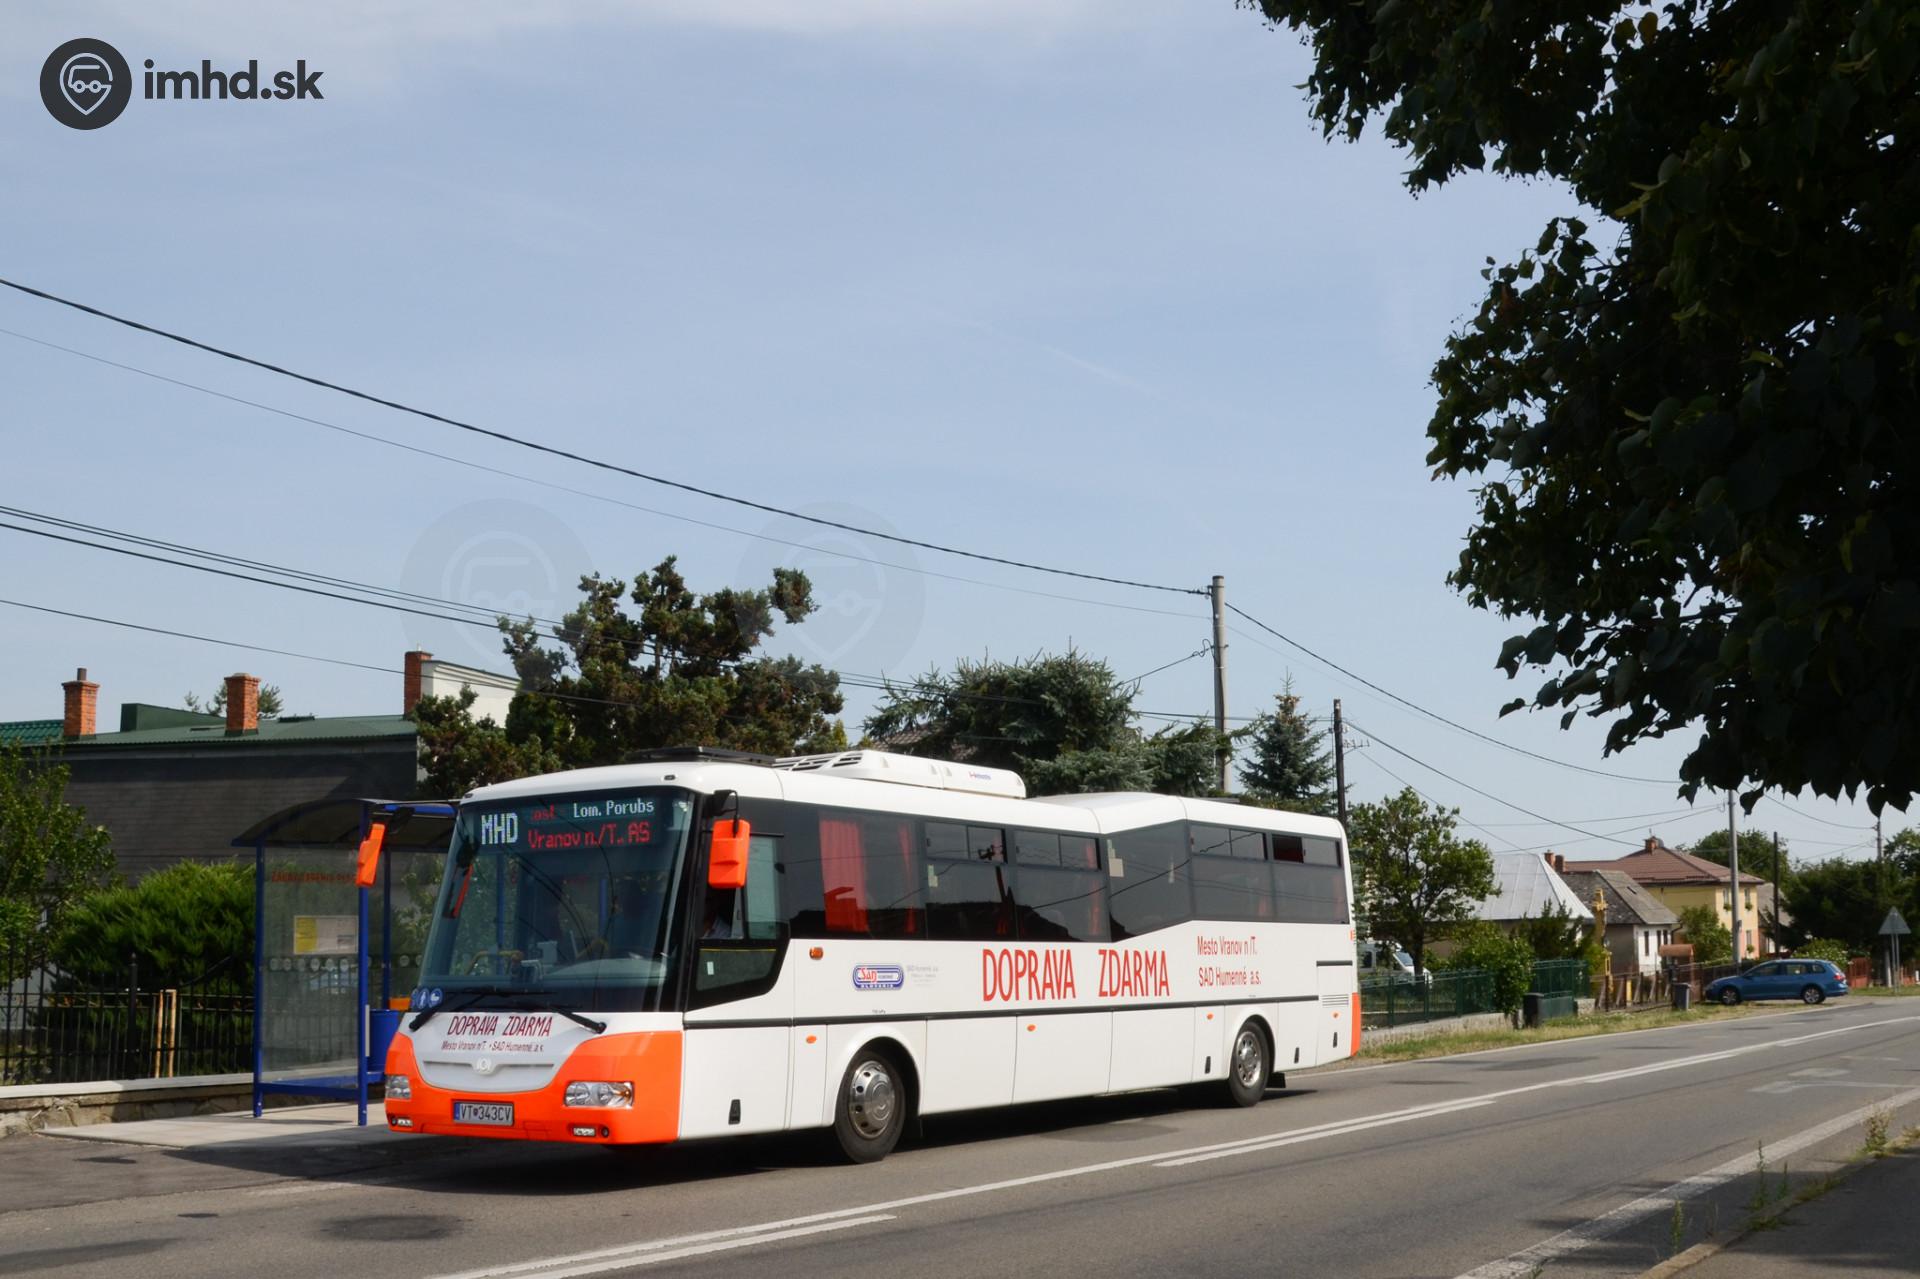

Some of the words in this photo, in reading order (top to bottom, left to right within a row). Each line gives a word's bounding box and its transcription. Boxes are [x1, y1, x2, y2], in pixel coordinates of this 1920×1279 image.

[573, 802, 602, 819] Lom.
[606, 798, 655, 816] Porubs
[481, 812, 518, 845] MHD
[527, 829, 582, 849] Vranov
[628, 821, 651, 844] AS
[1197, 936, 1218, 955] Mesto
[1219, 936, 1243, 955] Vranov
[982, 948, 1077, 1002] DOPRAVA
[1098, 949, 1170, 997] ZDARMA
[1199, 967, 1214, 987] SAD
[447, 1015, 499, 1036] DOPRAVA
[502, 1015, 553, 1037] ZDARMA
